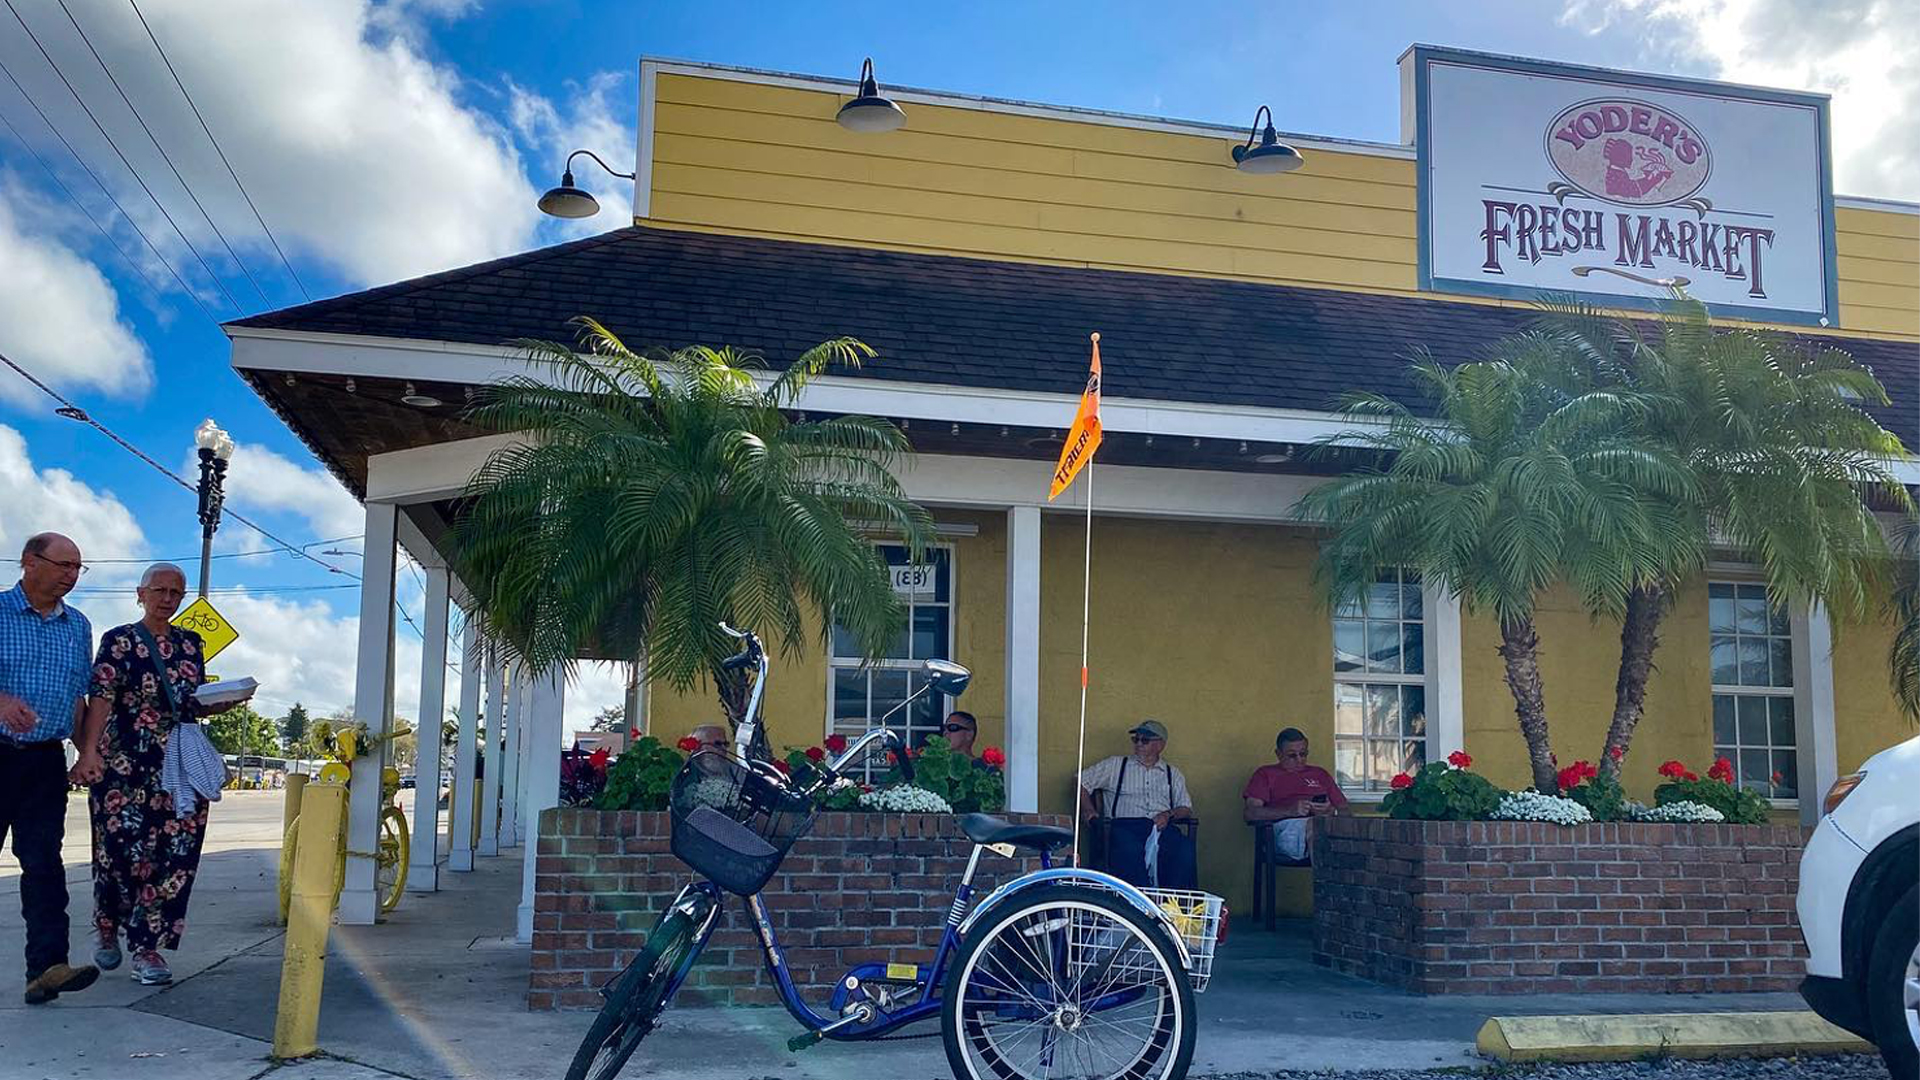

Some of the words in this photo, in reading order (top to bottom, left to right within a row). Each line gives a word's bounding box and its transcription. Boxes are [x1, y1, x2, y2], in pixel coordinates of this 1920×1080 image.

[1555, 105, 1703, 165] YODER'S
[1480, 199, 1606, 275] FRESH
[1613, 212, 1776, 299] MARKET
